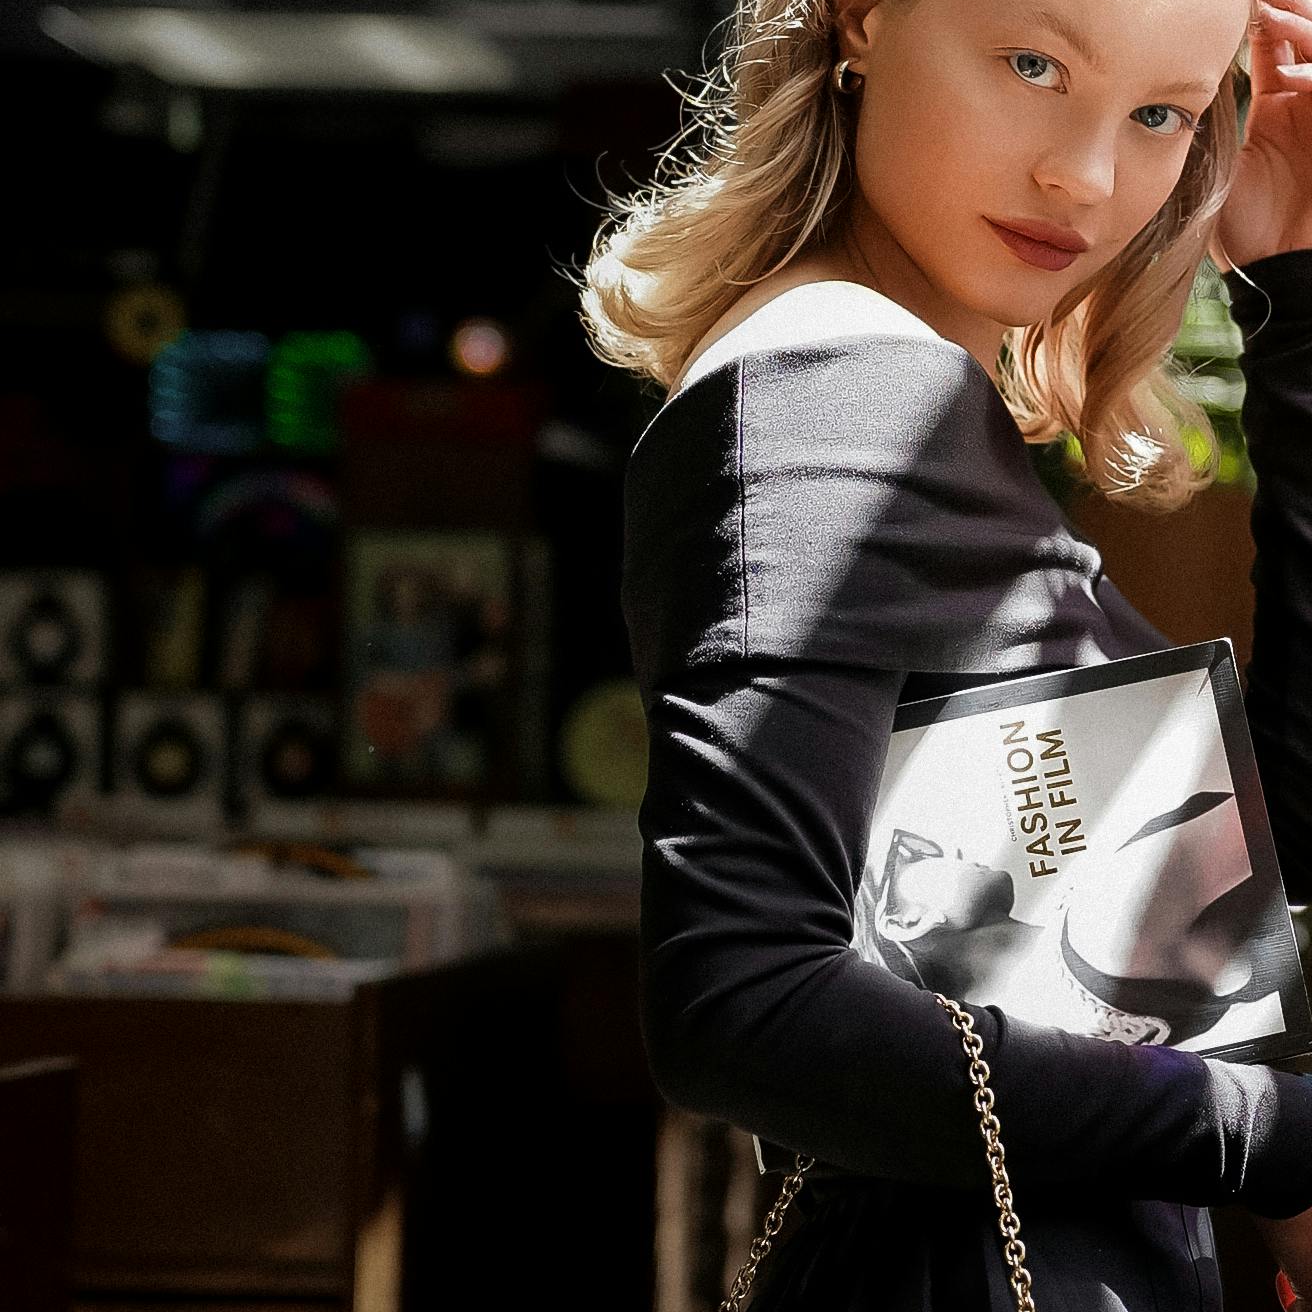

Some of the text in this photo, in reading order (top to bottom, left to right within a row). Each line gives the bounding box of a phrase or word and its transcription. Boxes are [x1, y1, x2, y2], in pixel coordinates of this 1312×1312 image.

[1000, 720, 1058, 877] FASHION
[1036, 728, 1087, 856] IN FILM
